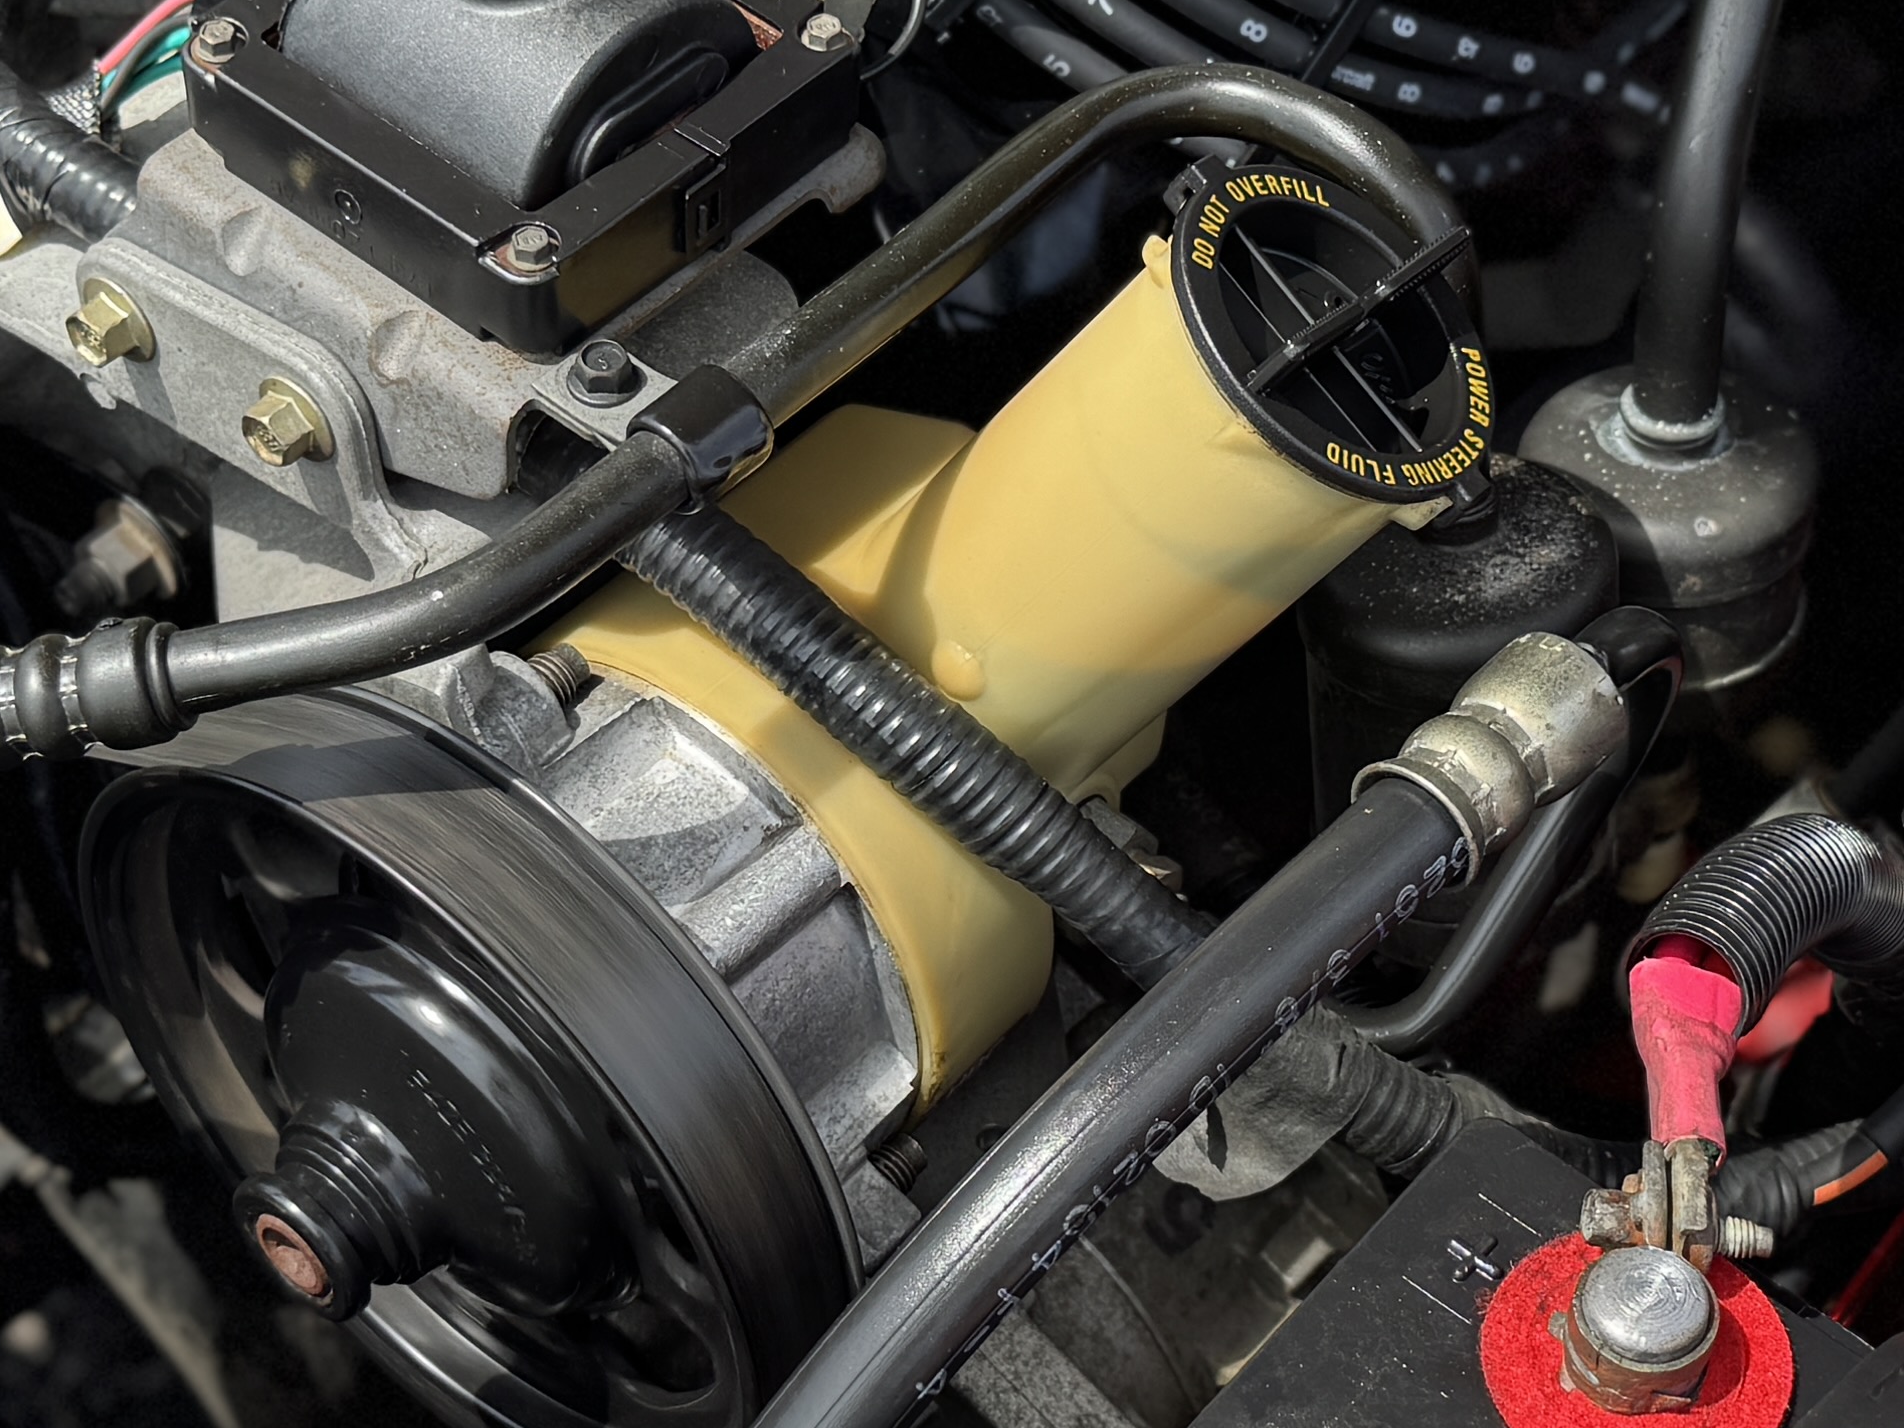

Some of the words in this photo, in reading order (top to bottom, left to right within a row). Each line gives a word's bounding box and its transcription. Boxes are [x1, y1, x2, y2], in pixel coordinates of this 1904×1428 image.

[1224, 172, 1331, 209] OVERFILL
[1198, 194, 1231, 237] NOT
[1191, 236, 1217, 269] DO
[1459, 346, 1493, 429] POWER
[1326, 441, 1397, 487] FLUID
[1402, 427, 1486, 488] STEERING
